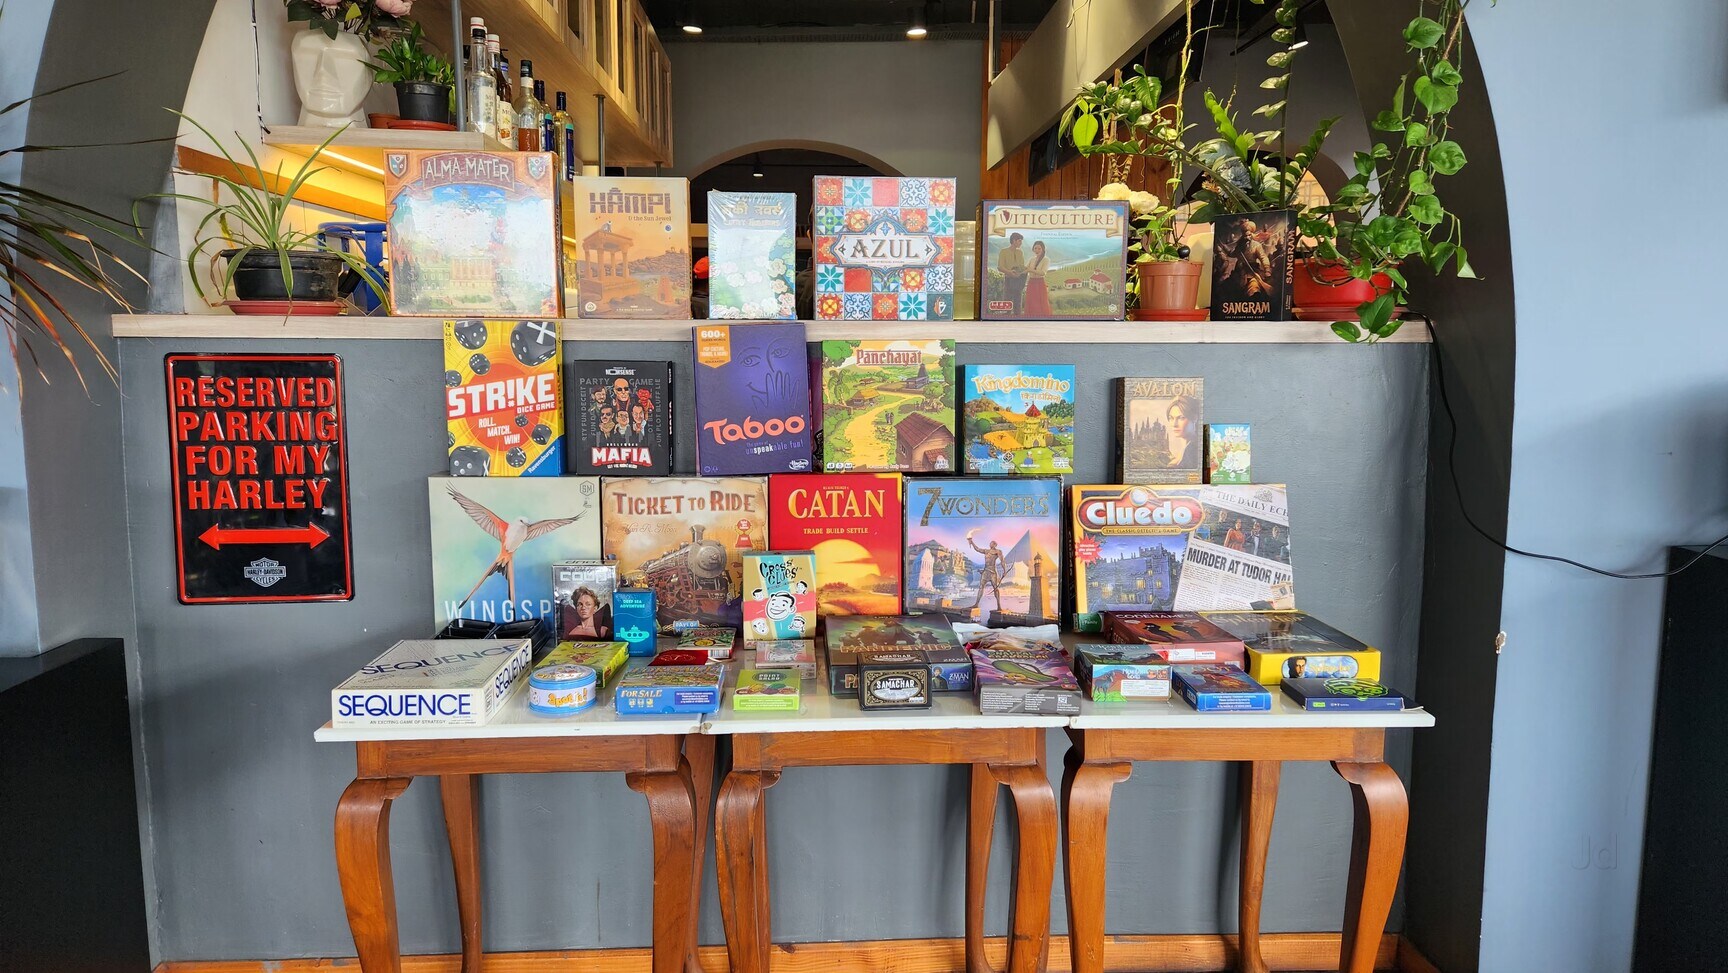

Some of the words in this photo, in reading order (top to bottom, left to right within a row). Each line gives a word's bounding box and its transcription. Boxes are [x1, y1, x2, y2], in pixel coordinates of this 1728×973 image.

[425, 157, 462, 181] ALMA
[464, 157, 511, 182] MATER
[999, 210, 1114, 226] VITICULTURE
[850, 239, 919, 259] AZUL
[1286, 229, 1296, 284] SANGRAM
[1222, 301, 1270, 314] SANGRAM
[701, 330, 726, 338] 600+
[856, 349, 922, 366] Panchayat
[175, 376, 335, 408] RESERVED
[628, 378, 654, 386] GAME
[971, 370, 1070, 393] Kingdomino
[1133, 380, 1196, 397] AVALON
[517, 405, 533, 414] DICE
[536, 401, 555, 410] GAME
[177, 410, 338, 443] PARKING
[478, 416, 497, 428] ROLL.
[487, 424, 512, 438] MATCH.
[703, 415, 805, 445] Taboo
[503, 433, 520, 445] WIN!
[789, 439, 804, 448] fun!
[185, 444, 259, 477] FOR
[274, 444, 331, 475] MY
[527, 445, 556, 474] Ravensburger
[591, 447, 652, 466] MAFIA
[186, 478, 329, 510] HARLEY
[582, 484, 592, 493] SM
[612, 491, 685, 516] TICKET
[687, 497, 706, 511] TO
[710, 490, 756, 513] RIDE
[788, 488, 886, 519] CATAN
[917, 487, 943, 527] 7
[941, 496, 1050, 516] WONDERS
[1216, 490, 1235, 502] THE
[1237, 495, 1268, 511] DAILY
[1086, 501, 1193, 526] Cluedo
[1187, 547, 1228, 571] MURDER
[1227, 559, 1242, 575] AT
[1241, 562, 1272, 583] TUDOR
[361, 643, 520, 675] SEQUENCE
[495, 645, 529, 698] SEQUENCE
[620, 690, 638, 698] FOR
[638, 689, 663, 698] SALE
[876, 680, 915, 689] SAMACHAR
[338, 693, 471, 717] SEQUENCE
